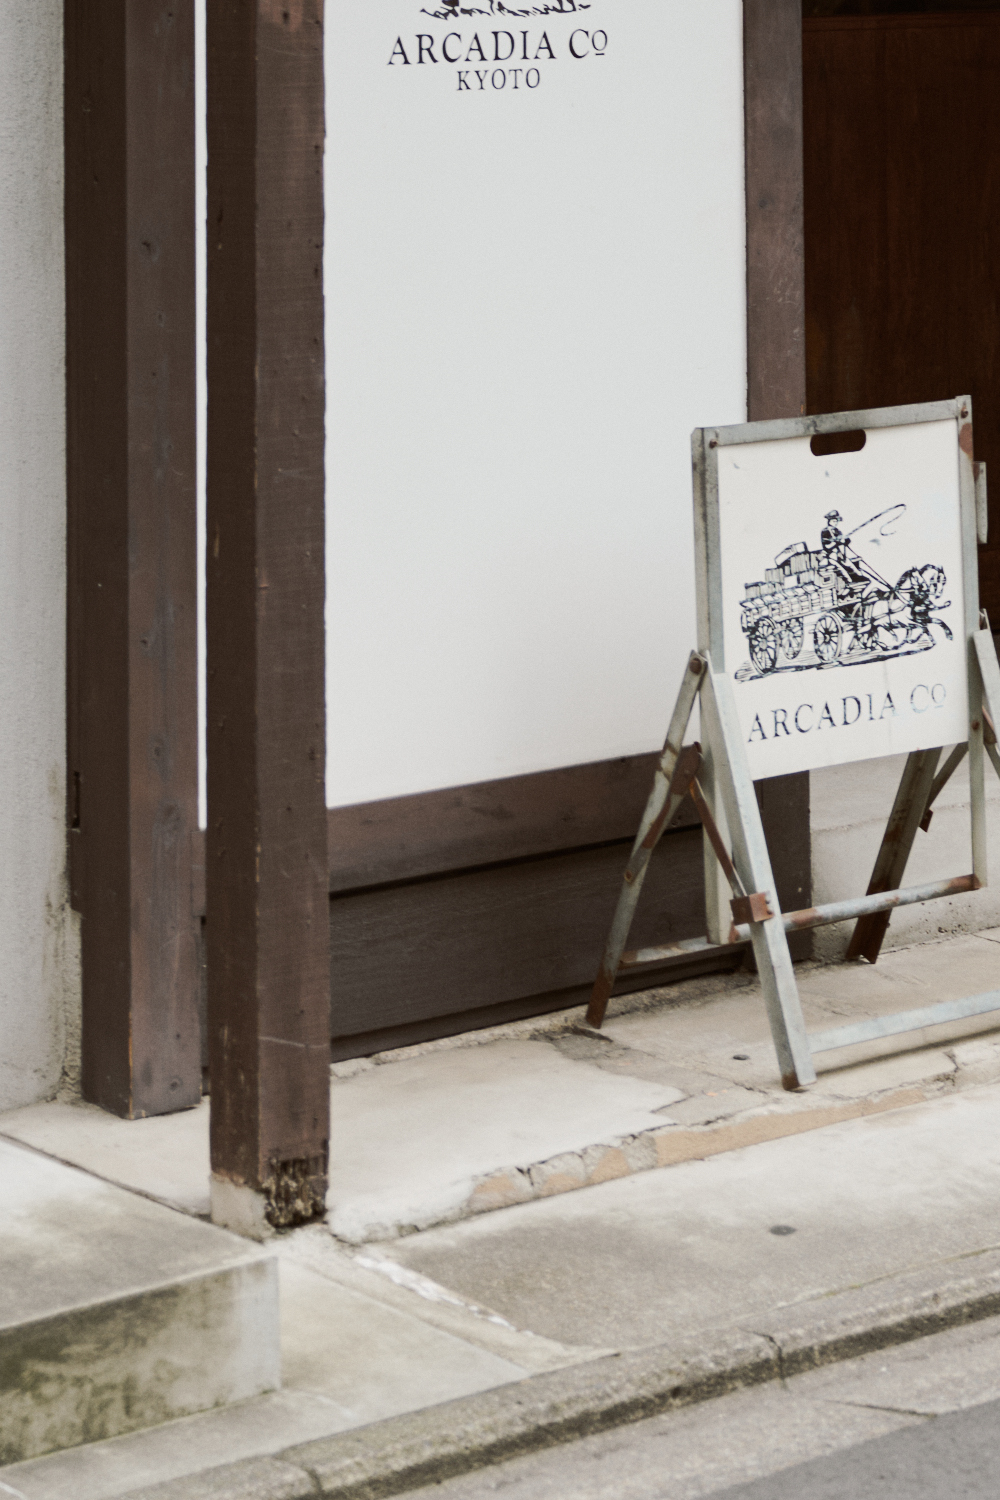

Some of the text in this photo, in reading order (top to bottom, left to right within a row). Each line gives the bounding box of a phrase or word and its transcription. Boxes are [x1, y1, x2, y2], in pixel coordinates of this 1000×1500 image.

[387, 30, 557, 65] ARCADIA
[457, 67, 541, 91] KYOTO
[747, 690, 897, 743] ARCADIA
